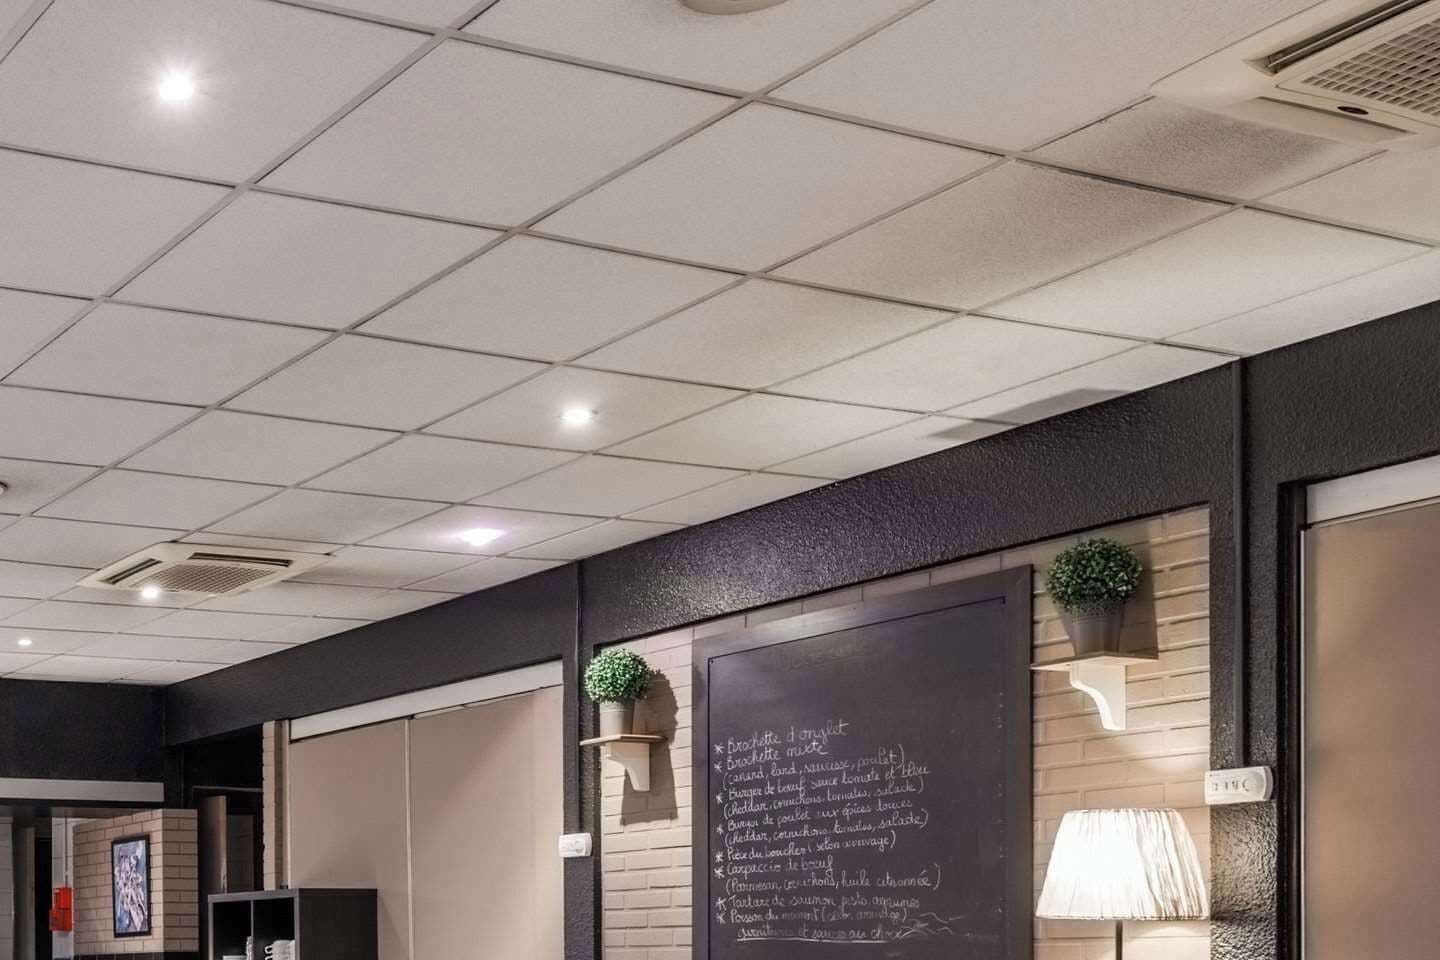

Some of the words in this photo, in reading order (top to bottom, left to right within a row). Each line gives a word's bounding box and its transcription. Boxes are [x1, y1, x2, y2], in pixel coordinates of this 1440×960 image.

[727, 746, 782, 770] Brochette
[786, 739, 829, 757] mixte
[841, 768, 881, 784] tomate
[726, 861, 781, 880] Carpaccio
[841, 869, 872, 887] huile
[772, 894, 785, 906] de
